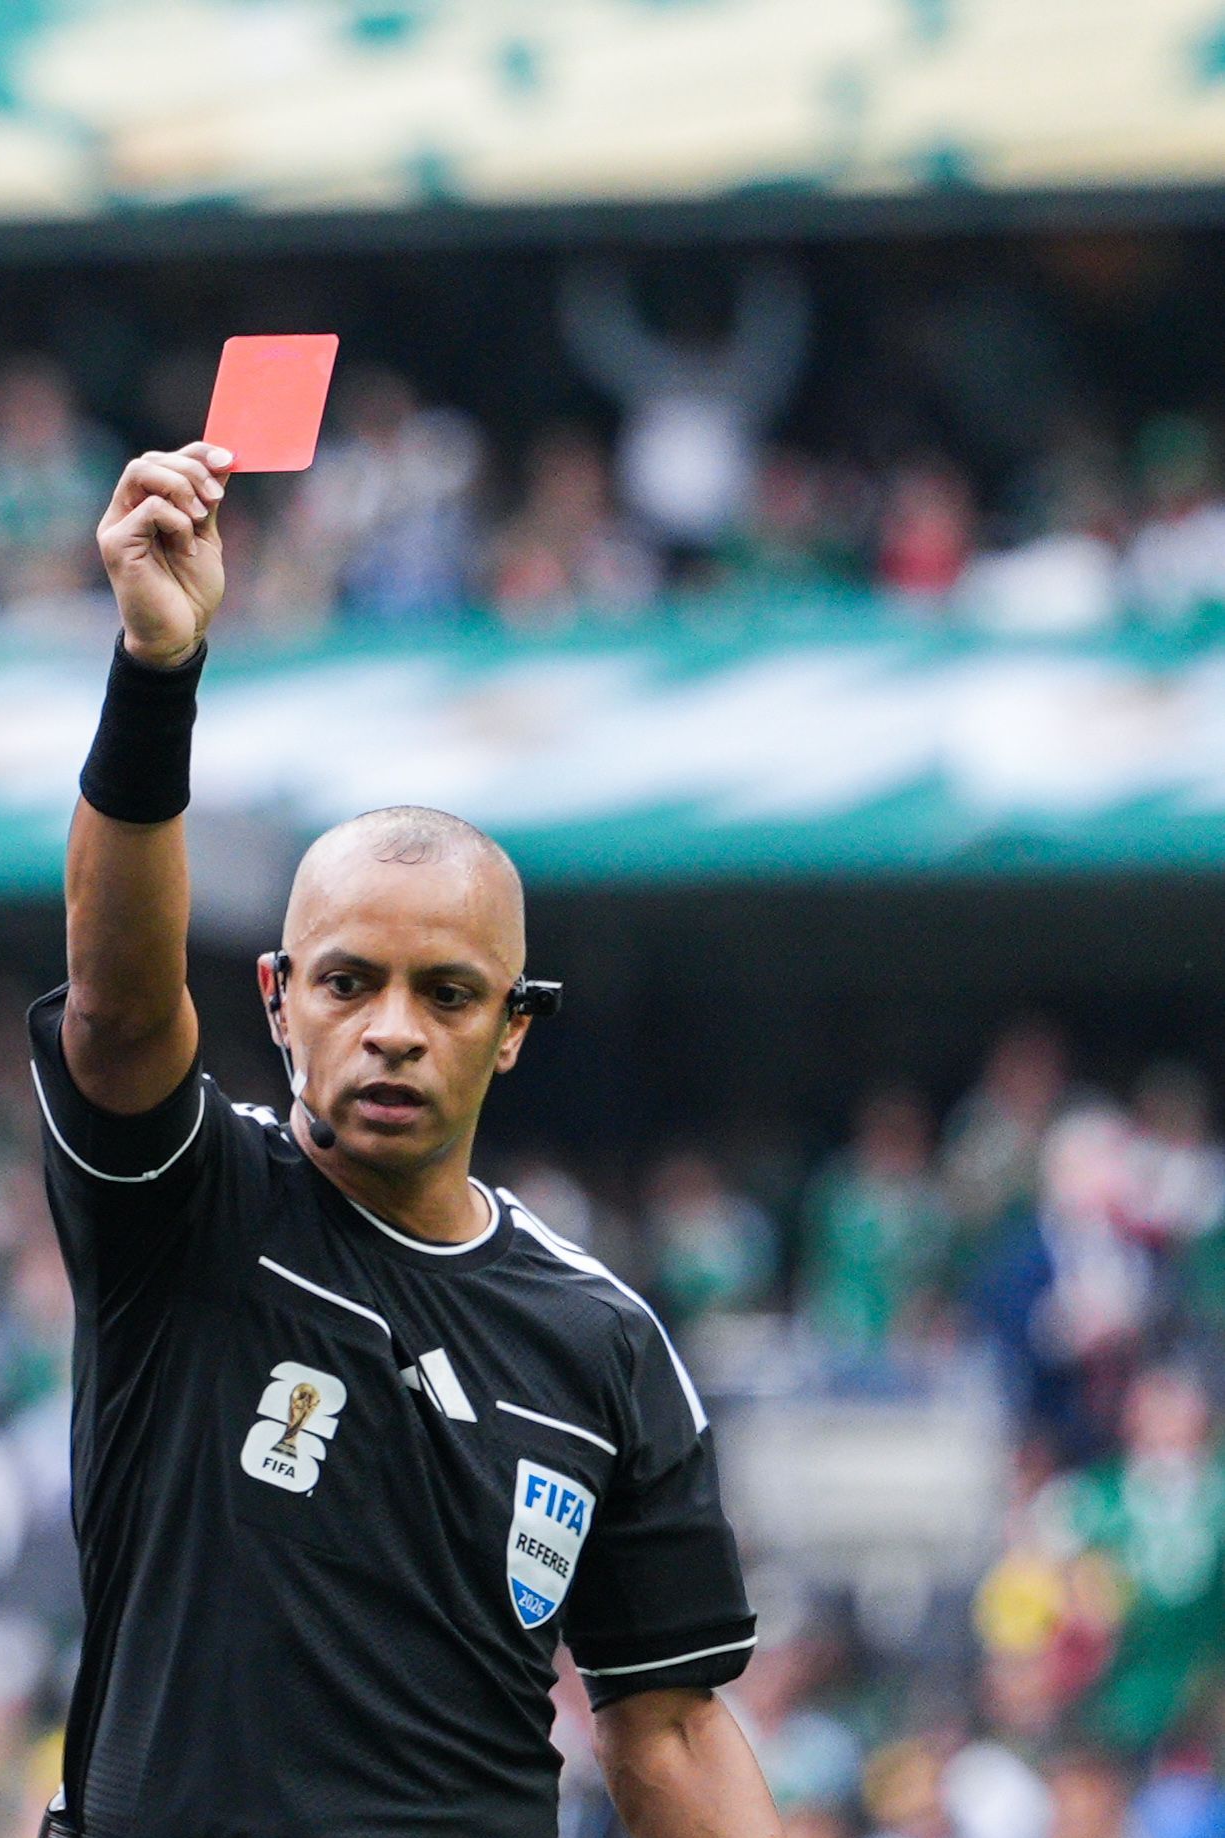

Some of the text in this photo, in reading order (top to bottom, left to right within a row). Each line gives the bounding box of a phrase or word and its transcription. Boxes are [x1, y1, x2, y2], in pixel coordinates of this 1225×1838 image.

[262, 1457, 296, 1479] FIFA
[524, 1474, 586, 1537] FIFA
[515, 1532, 571, 1579] REFEREE
